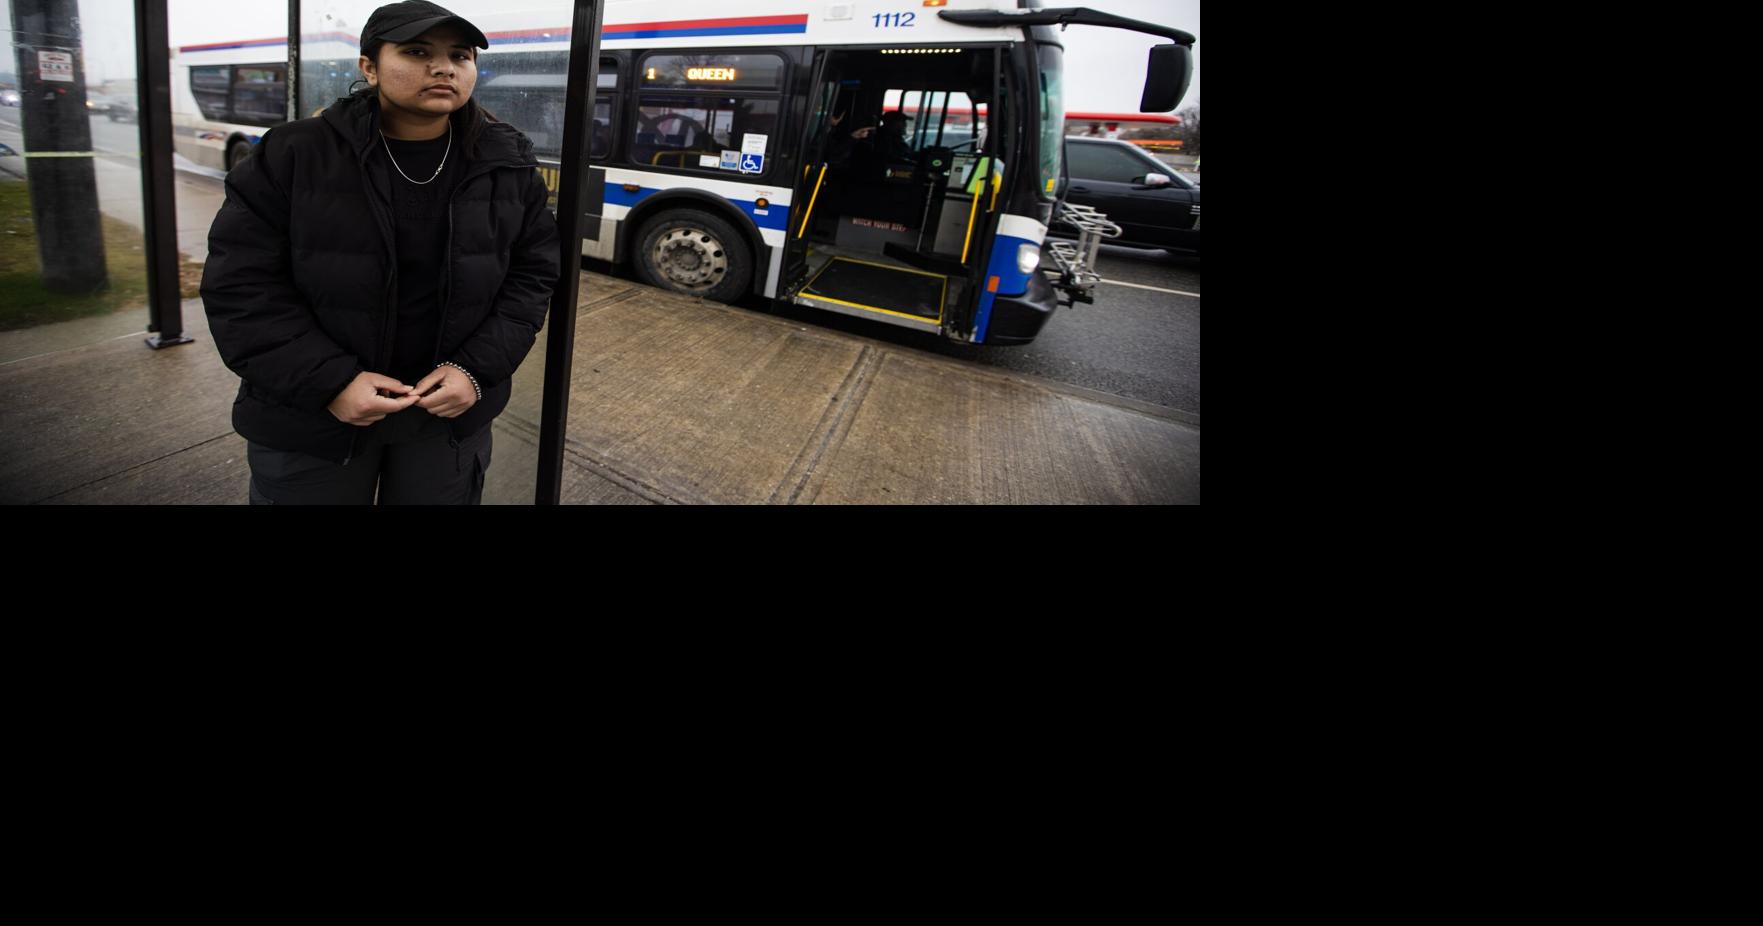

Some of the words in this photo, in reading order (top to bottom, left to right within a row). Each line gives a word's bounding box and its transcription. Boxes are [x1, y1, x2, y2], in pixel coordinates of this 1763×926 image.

[872, 12, 915, 27] 1112
[647, 68, 655, 79] 1
[687, 68, 736, 80] QUEEN
